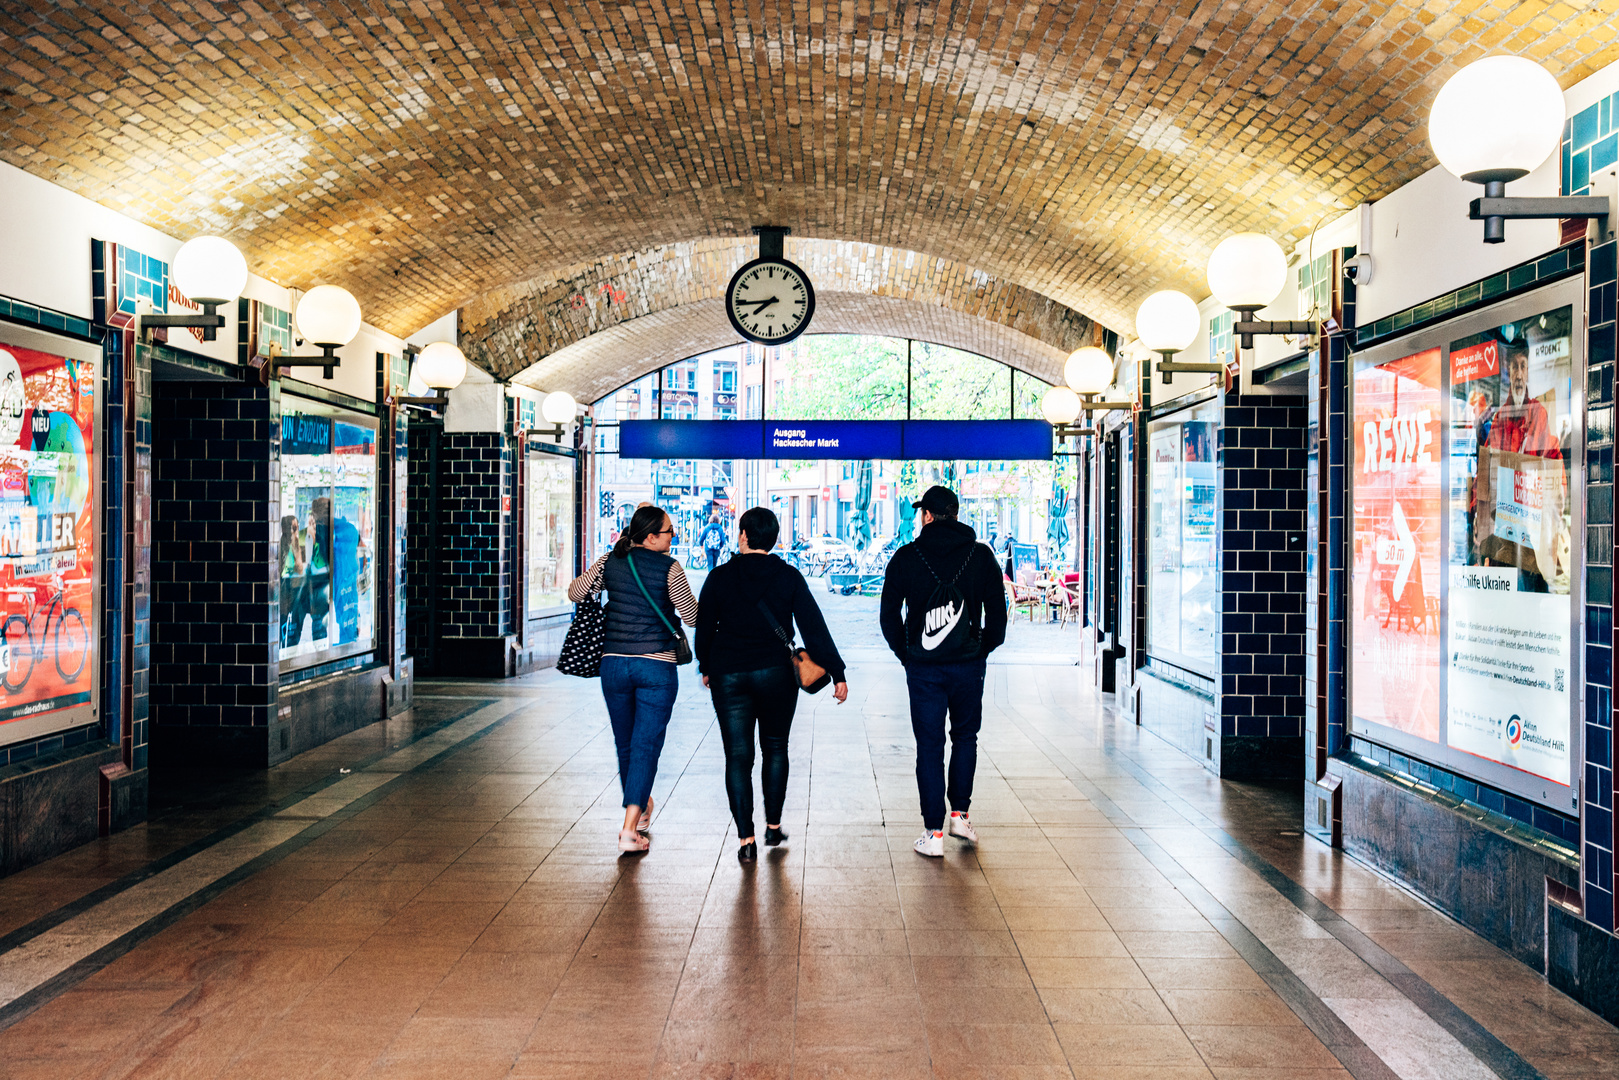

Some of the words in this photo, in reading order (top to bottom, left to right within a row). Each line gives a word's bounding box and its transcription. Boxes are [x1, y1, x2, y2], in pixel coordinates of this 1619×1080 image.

[1455, 354, 1469, 367] Danke
[1468, 353, 1475, 363] an
[1456, 367, 1464, 379] die
[1463, 363, 1479, 377] helfen!
[32, 416, 49, 433] NEU
[773, 428, 806, 439] Ausgang
[1363, 409, 1432, 474] REWE
[773, 438, 816, 448] Hackescher
[817, 438, 839, 448] Markt
[661, 486, 682, 496] PUMA
[1481, 574, 1511, 592] Ukraine
[925, 600, 957, 634] NIKE
[1522, 731, 1551, 748] Deutschland
[1552, 739, 1565, 752] Hilft
